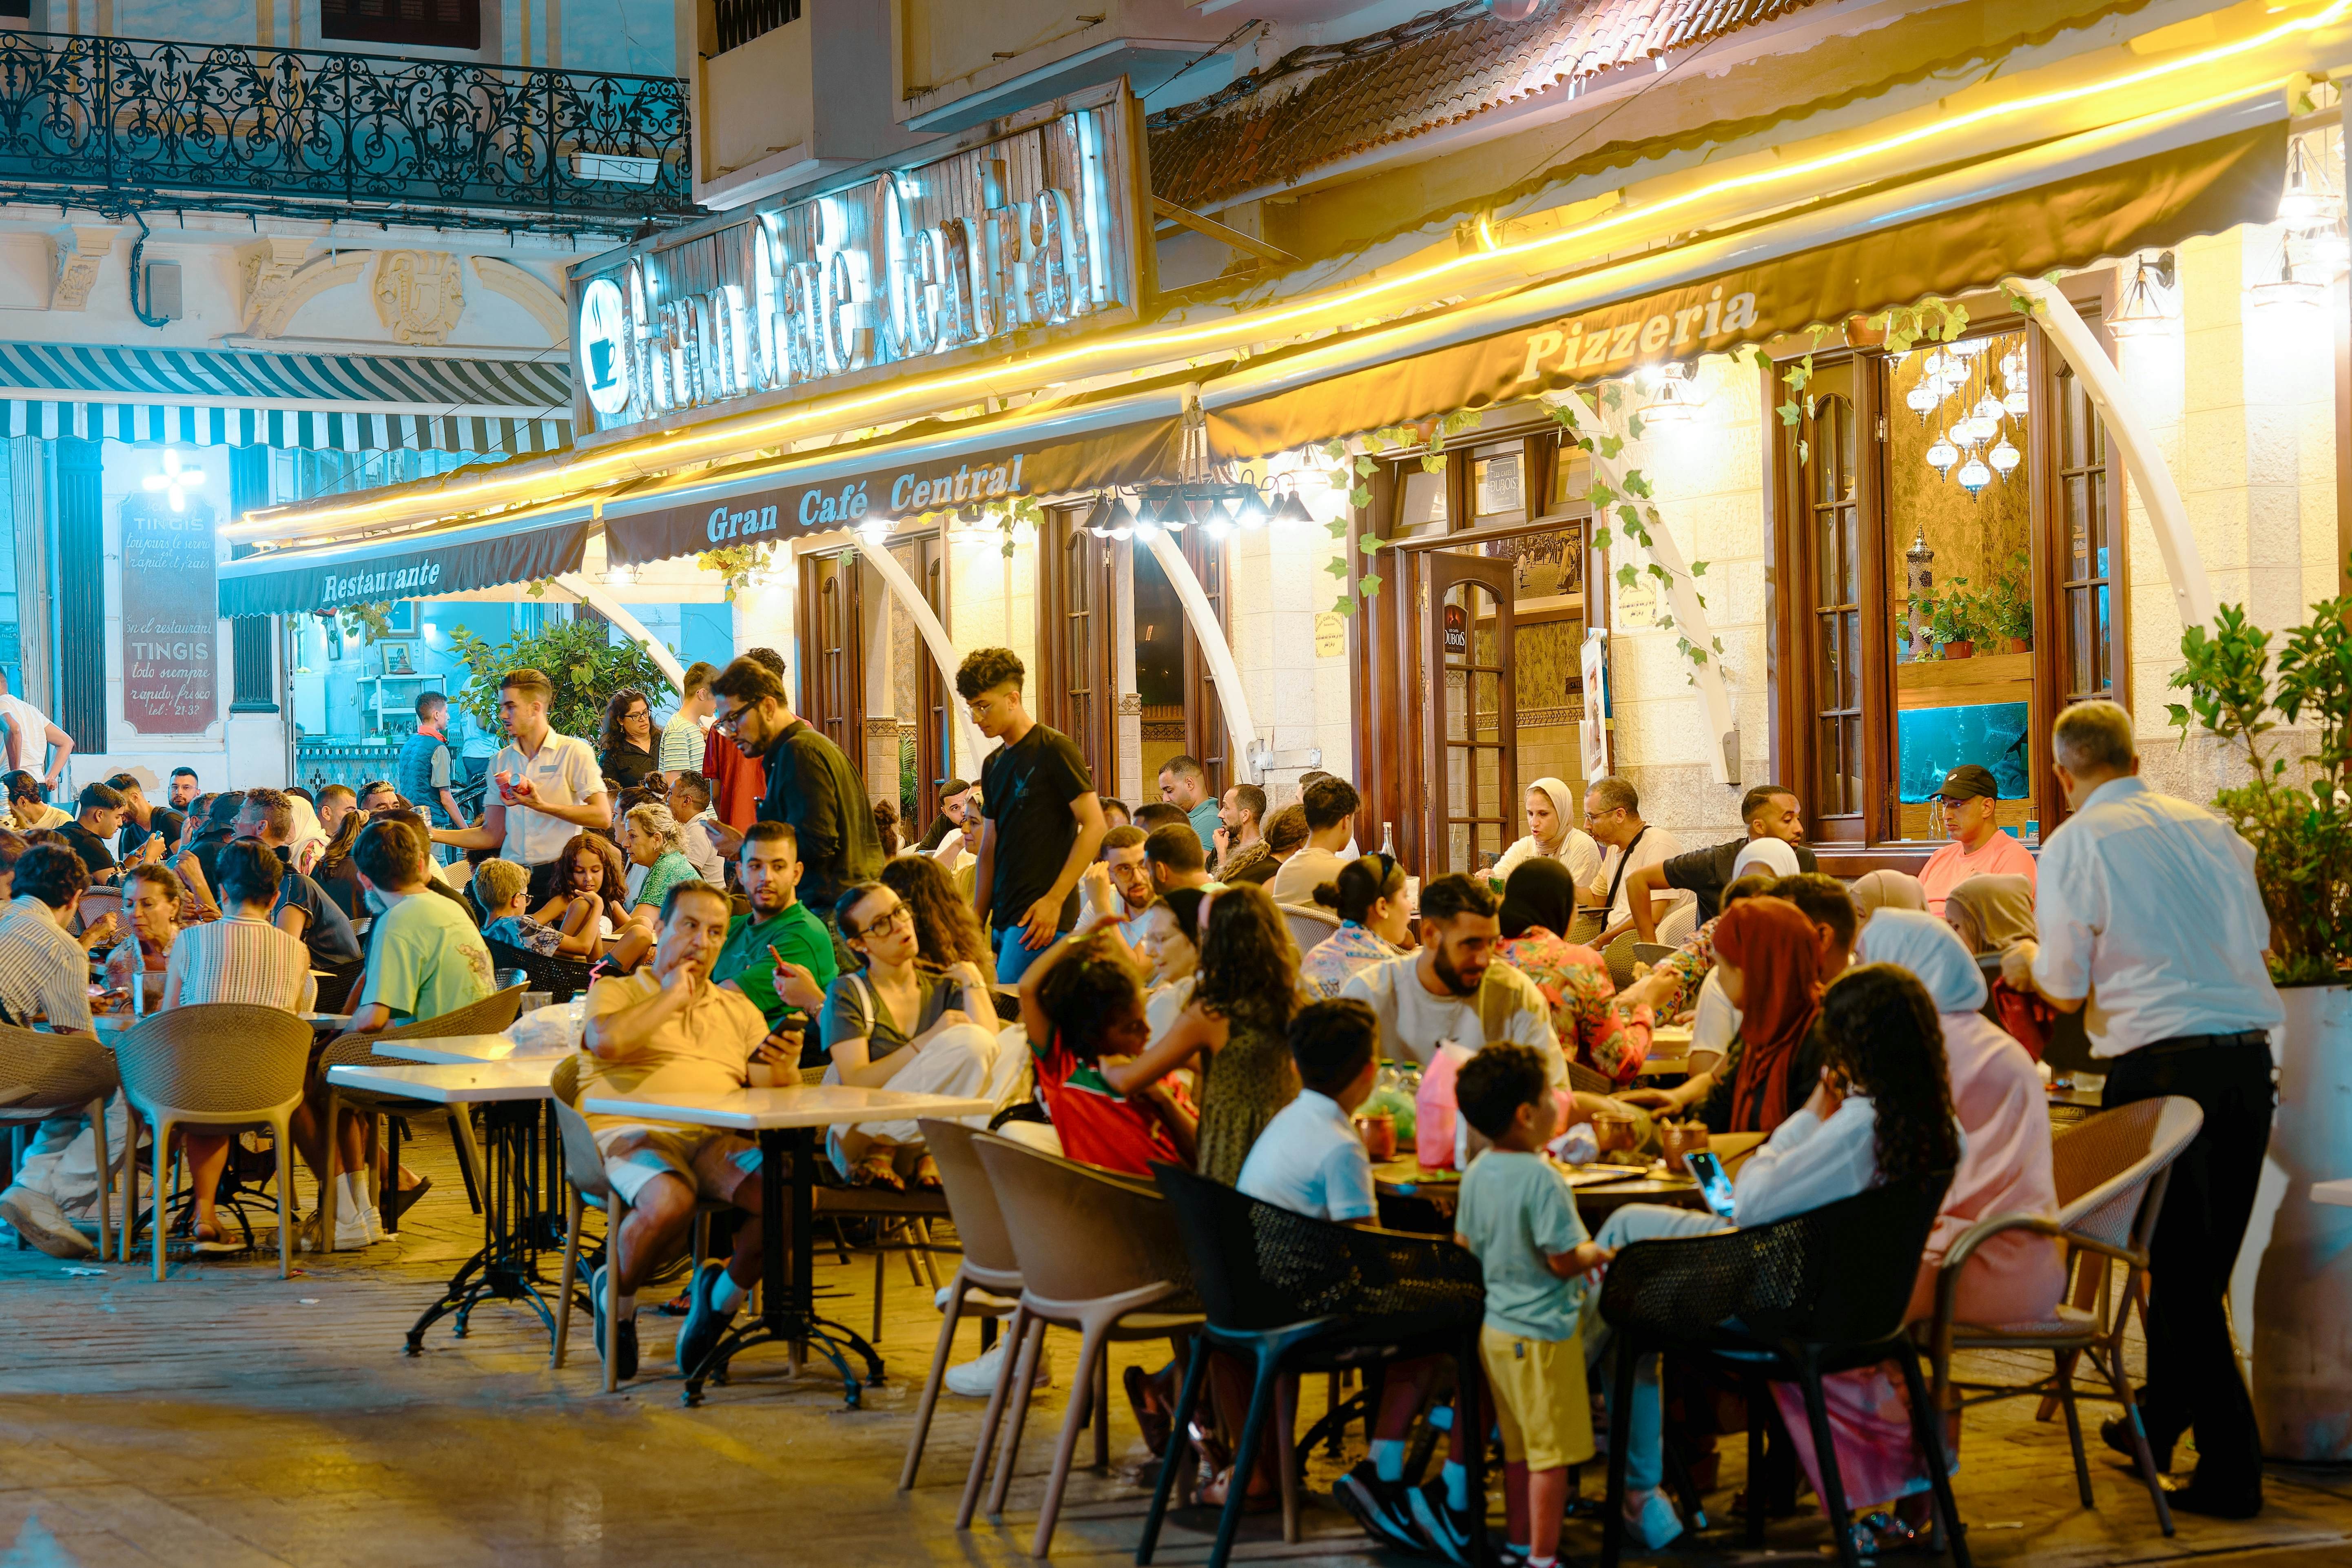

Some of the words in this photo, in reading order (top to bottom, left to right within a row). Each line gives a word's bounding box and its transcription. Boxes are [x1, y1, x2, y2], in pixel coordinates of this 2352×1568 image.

[622, 257, 746, 420] Gran
[874, 111, 1107, 358] Central
[1516, 285, 1759, 383] Pizzeria
[1490, 476, 1519, 494] DUBOIS
[706, 505, 778, 543] Gran
[798, 480, 868, 527] Café
[890, 454, 1025, 512] Central
[133, 517, 204, 531] TINGIS
[126, 532, 170, 555] toujours
[173, 533, 182, 549] le
[129, 556, 168, 574] rapide
[322, 558, 441, 603] Restaurante
[132, 642, 208, 660] TINGIS
[132, 662, 155, 678] todo
